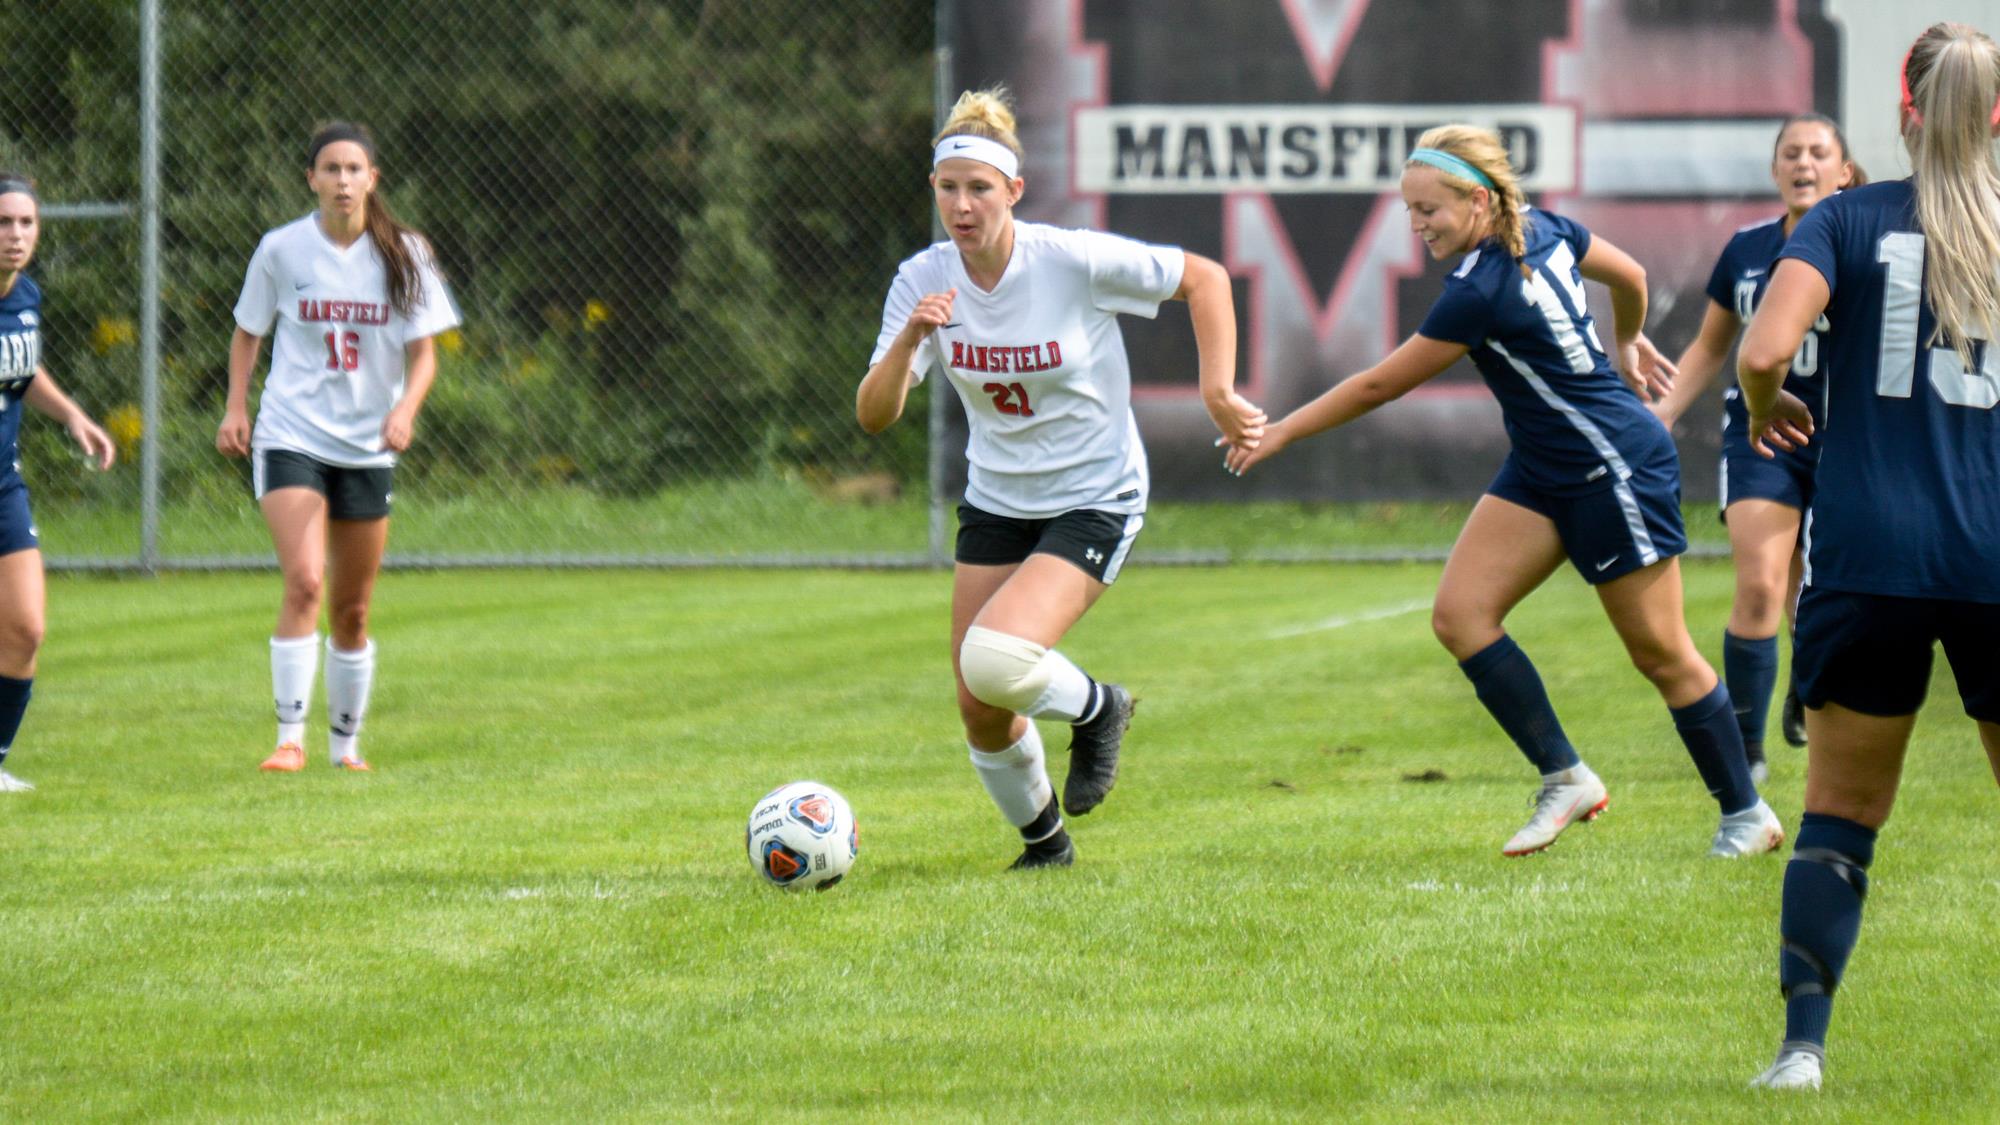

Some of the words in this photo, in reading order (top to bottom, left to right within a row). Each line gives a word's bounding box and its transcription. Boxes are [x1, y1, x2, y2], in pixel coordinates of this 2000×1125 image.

[1113, 122, 1541, 181] MANSFID
[298, 300, 389, 325] MANSFIELD
[1522, 238, 1604, 373] 15
[324, 331, 359, 371] 16
[951, 341, 1062, 373] MANSFIELD
[983, 382, 1034, 417] 21
